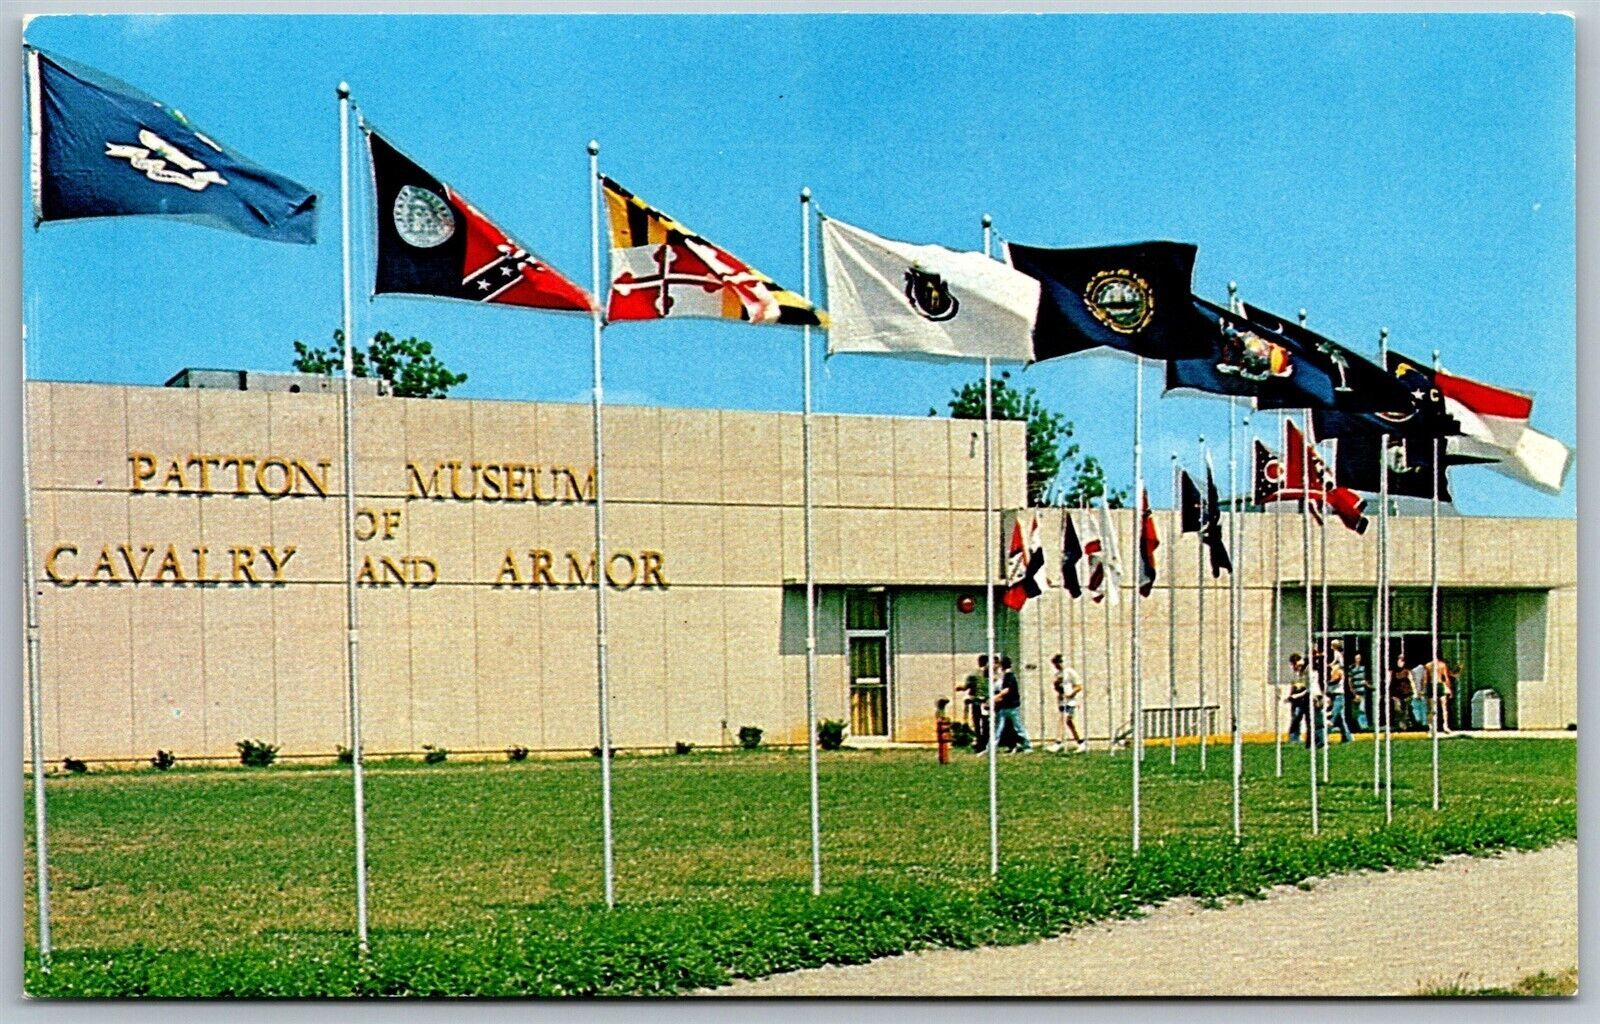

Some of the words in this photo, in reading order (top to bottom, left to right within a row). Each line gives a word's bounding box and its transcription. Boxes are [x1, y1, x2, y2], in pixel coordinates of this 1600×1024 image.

[128, 451, 331, 498] PATTON
[405, 461, 597, 504] MUSEUM
[354, 508, 401, 541] OF
[45, 543, 297, 587] CAVALRY
[355, 554, 439, 589] AND
[491, 549, 670, 591] ARMOR
